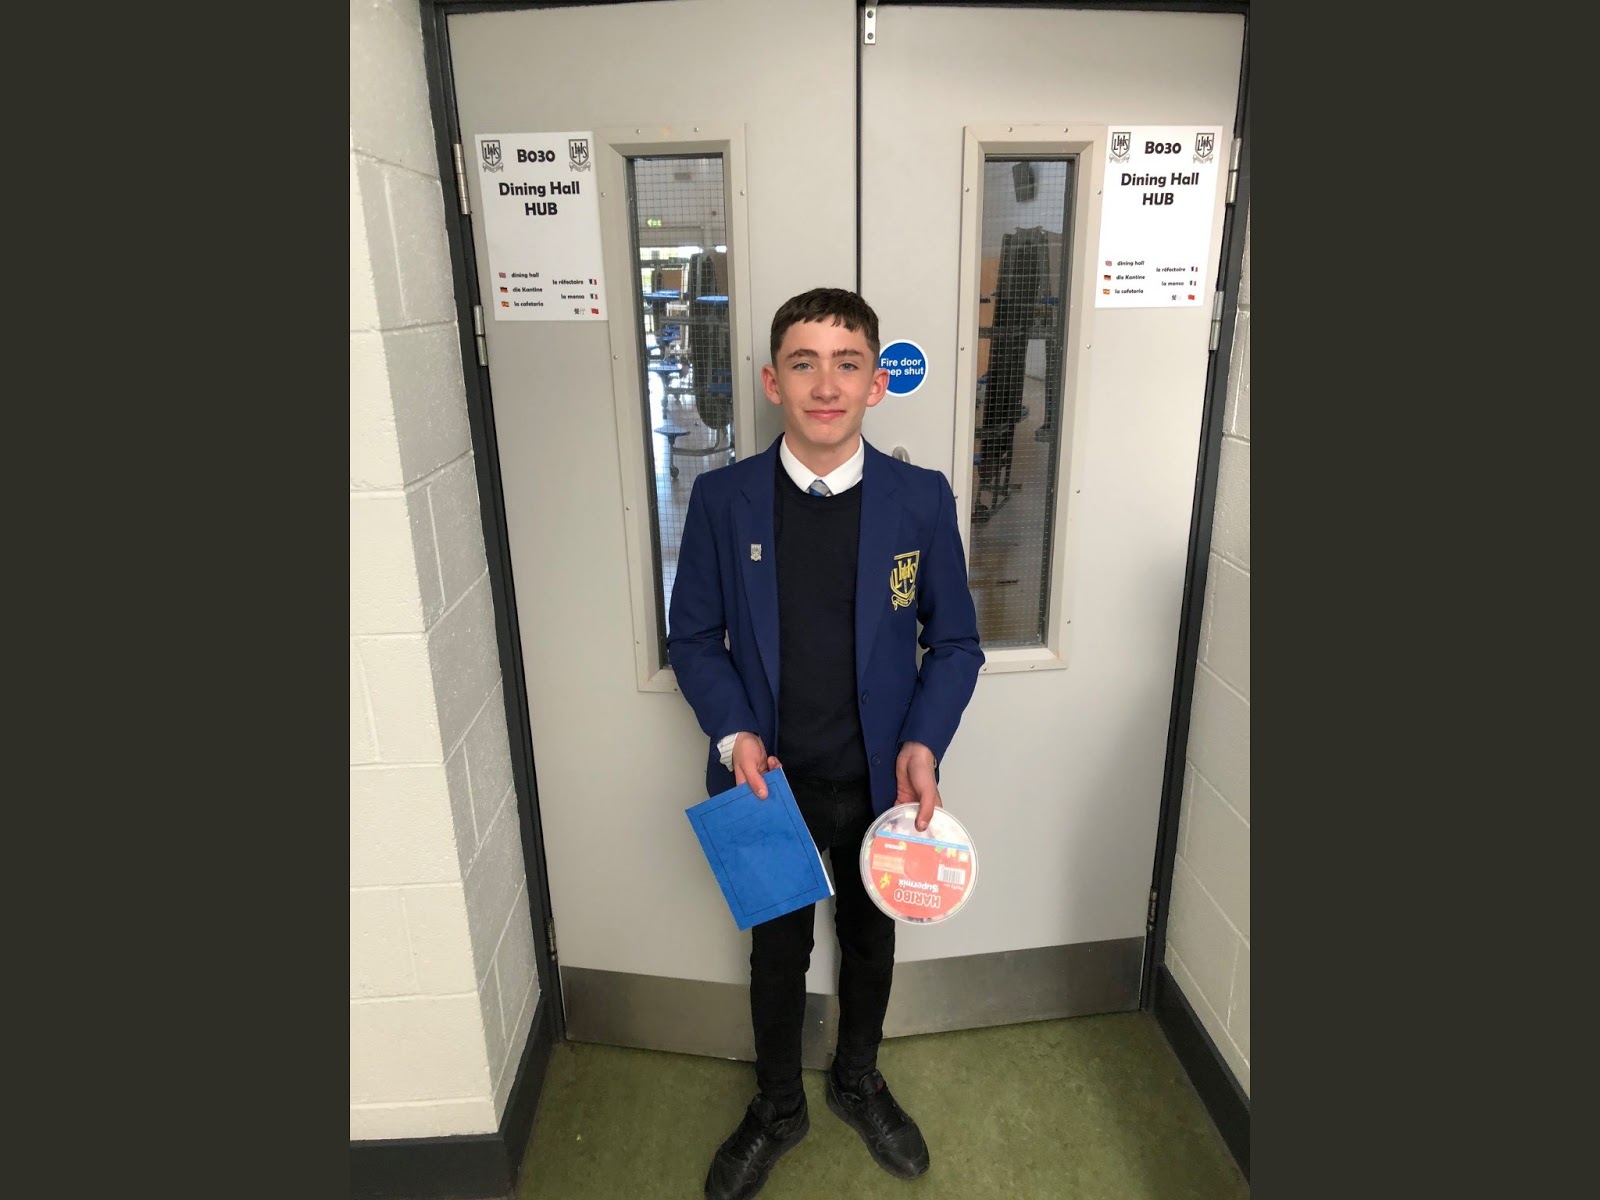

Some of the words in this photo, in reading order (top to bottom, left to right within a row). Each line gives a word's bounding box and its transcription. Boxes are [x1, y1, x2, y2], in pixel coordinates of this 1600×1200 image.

[1121, 172, 1167, 188] Dining
[1170, 172, 1200, 185] Hall
[498, 182, 546, 197] Dining
[549, 181, 580, 195] Hall
[1142, 192, 1175, 205] HUB
[524, 202, 558, 216] HUB
[880, 358, 898, 367] Fire
[900, 357, 922, 366] door
[904, 367, 925, 376] shut
[898, 879, 940, 893] Supermix
[894, 889, 941, 909] HARIBO
